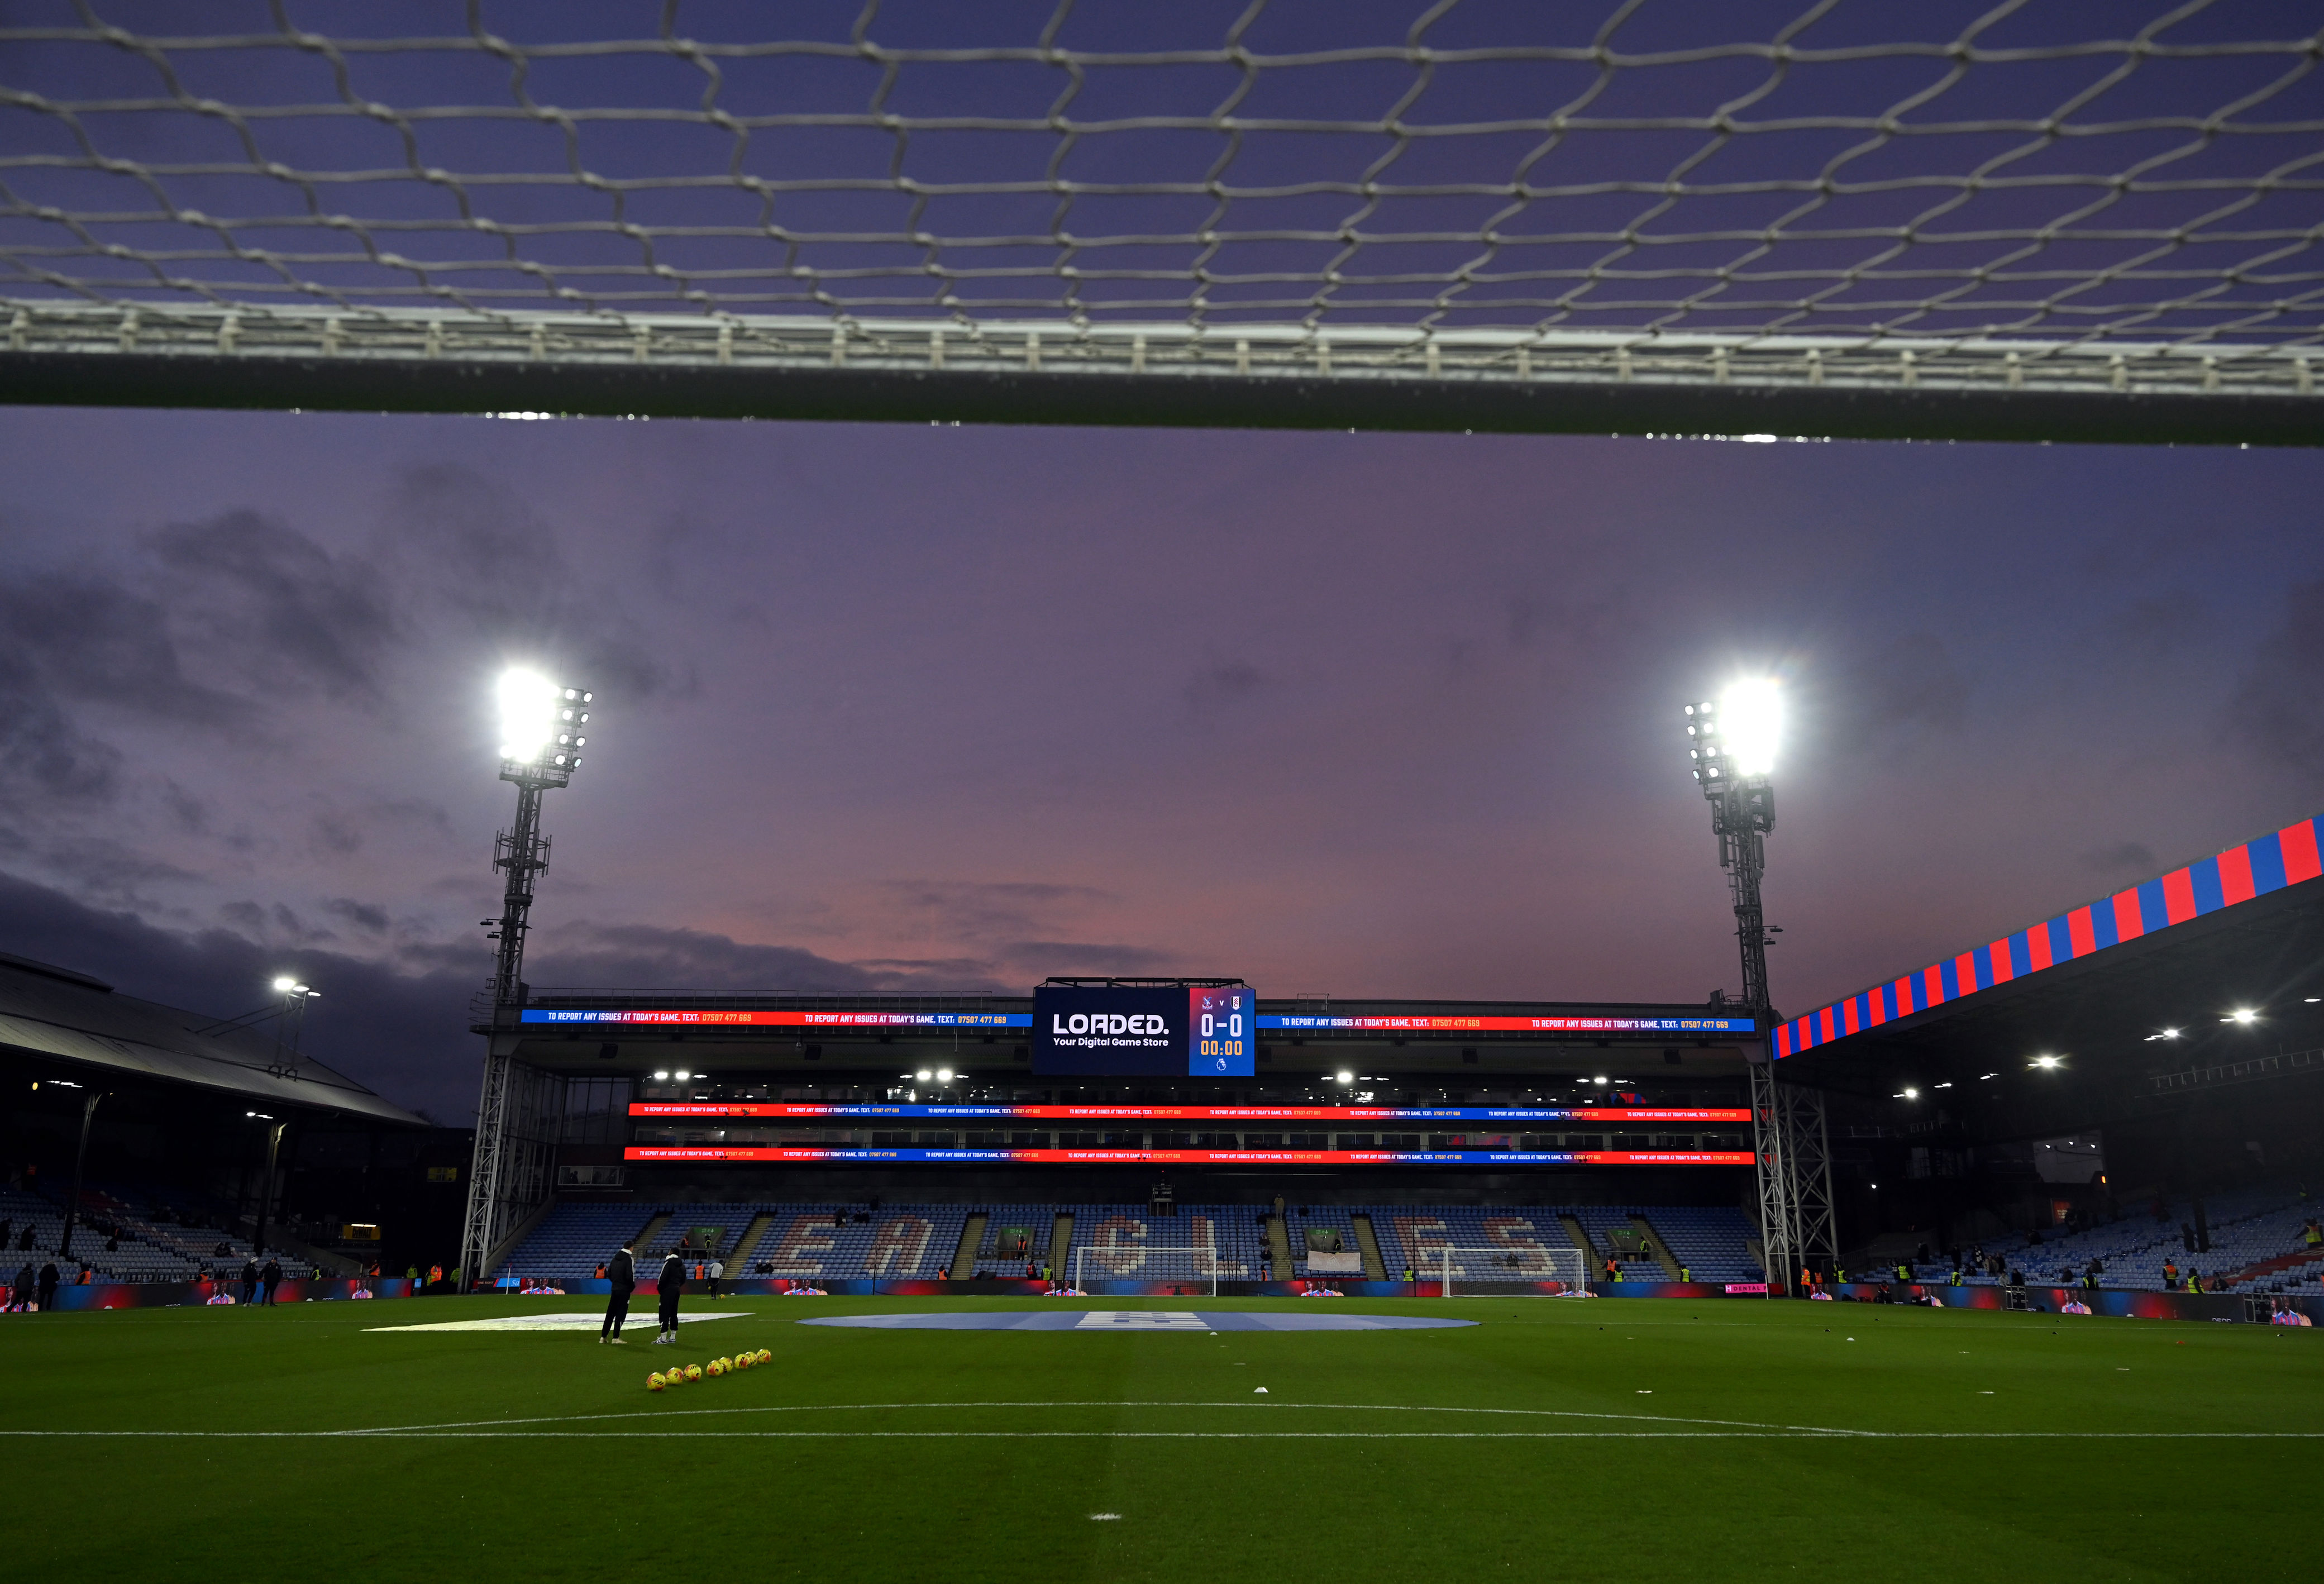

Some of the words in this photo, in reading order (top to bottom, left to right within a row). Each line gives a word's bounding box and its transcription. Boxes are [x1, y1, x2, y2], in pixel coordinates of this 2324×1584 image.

[1053, 1014, 1169, 1034] LOADED.
[1201, 1014, 1242, 1037] 0-0
[1078, 1037, 1110, 1048] Digital
[1201, 1041, 1242, 1055] 00:00
